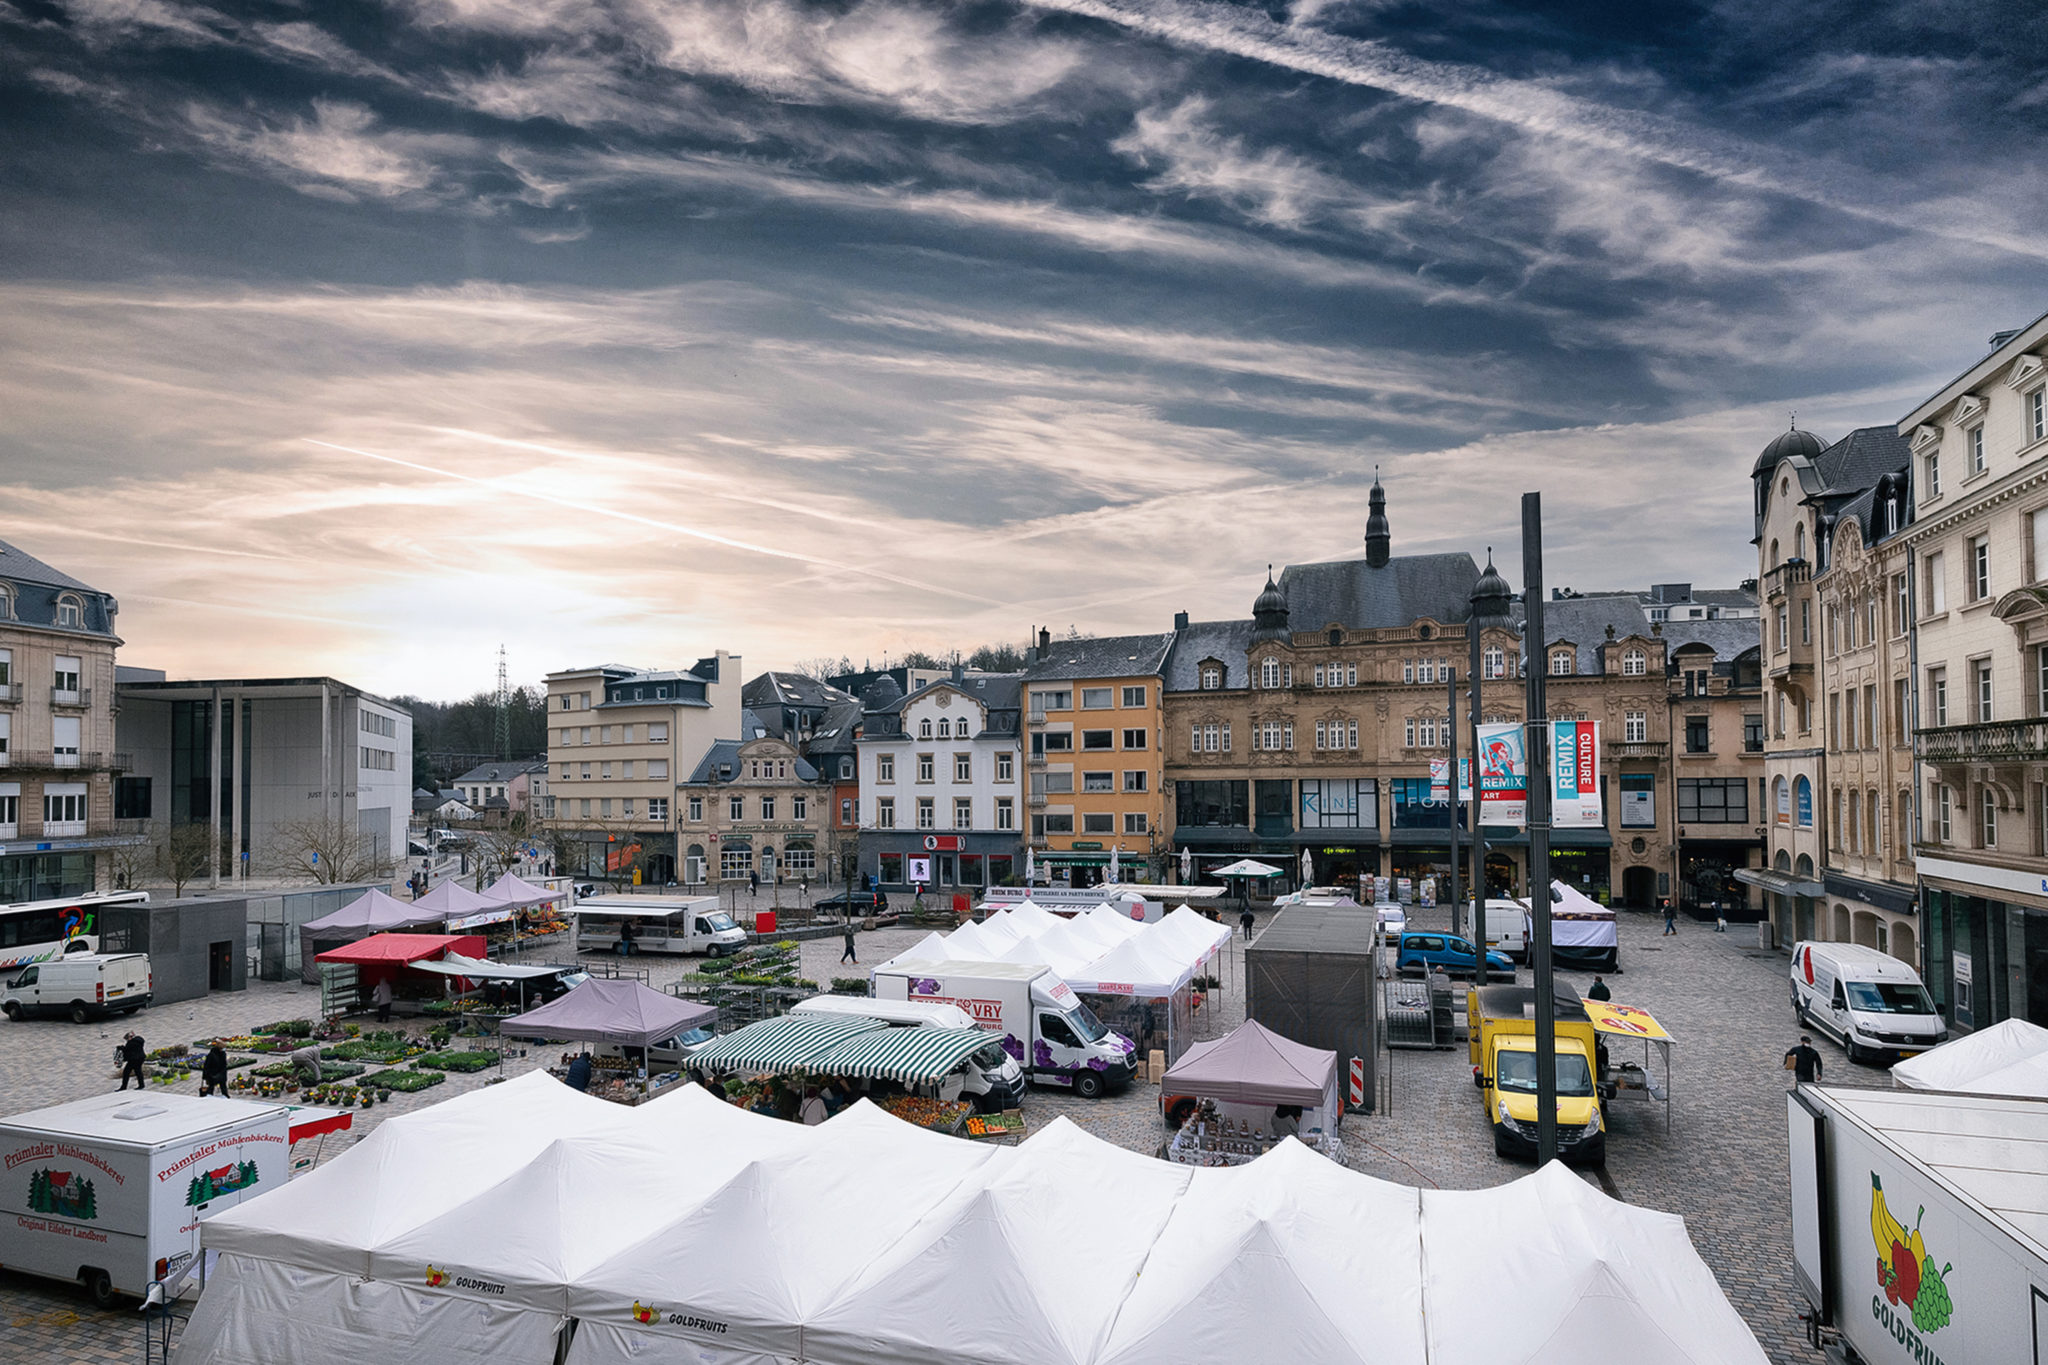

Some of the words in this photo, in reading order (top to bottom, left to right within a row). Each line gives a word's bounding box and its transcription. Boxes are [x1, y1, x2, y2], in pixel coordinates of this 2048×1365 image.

[1557, 734, 1575, 789] REMIX
[1580, 733, 1592, 785] CULTURE
[1482, 777, 1523, 788] REMIX
[973, 1004, 1002, 1018] VRY
[4, 1142, 55, 1169] Prümtaler
[56, 1143, 126, 1186] Mühlenbäckerei
[157, 1143, 217, 1182] Prümtaler
[217, 1133, 285, 1151] Mühlenbäckerei
[17, 1216, 46, 1232] Original
[47, 1221, 73, 1237] Eifeler
[72, 1227, 108, 1243] Landbrot
[456, 1276, 506, 1295] GOLDFRUITS
[669, 1313, 728, 1334] GOLDFRUITS
